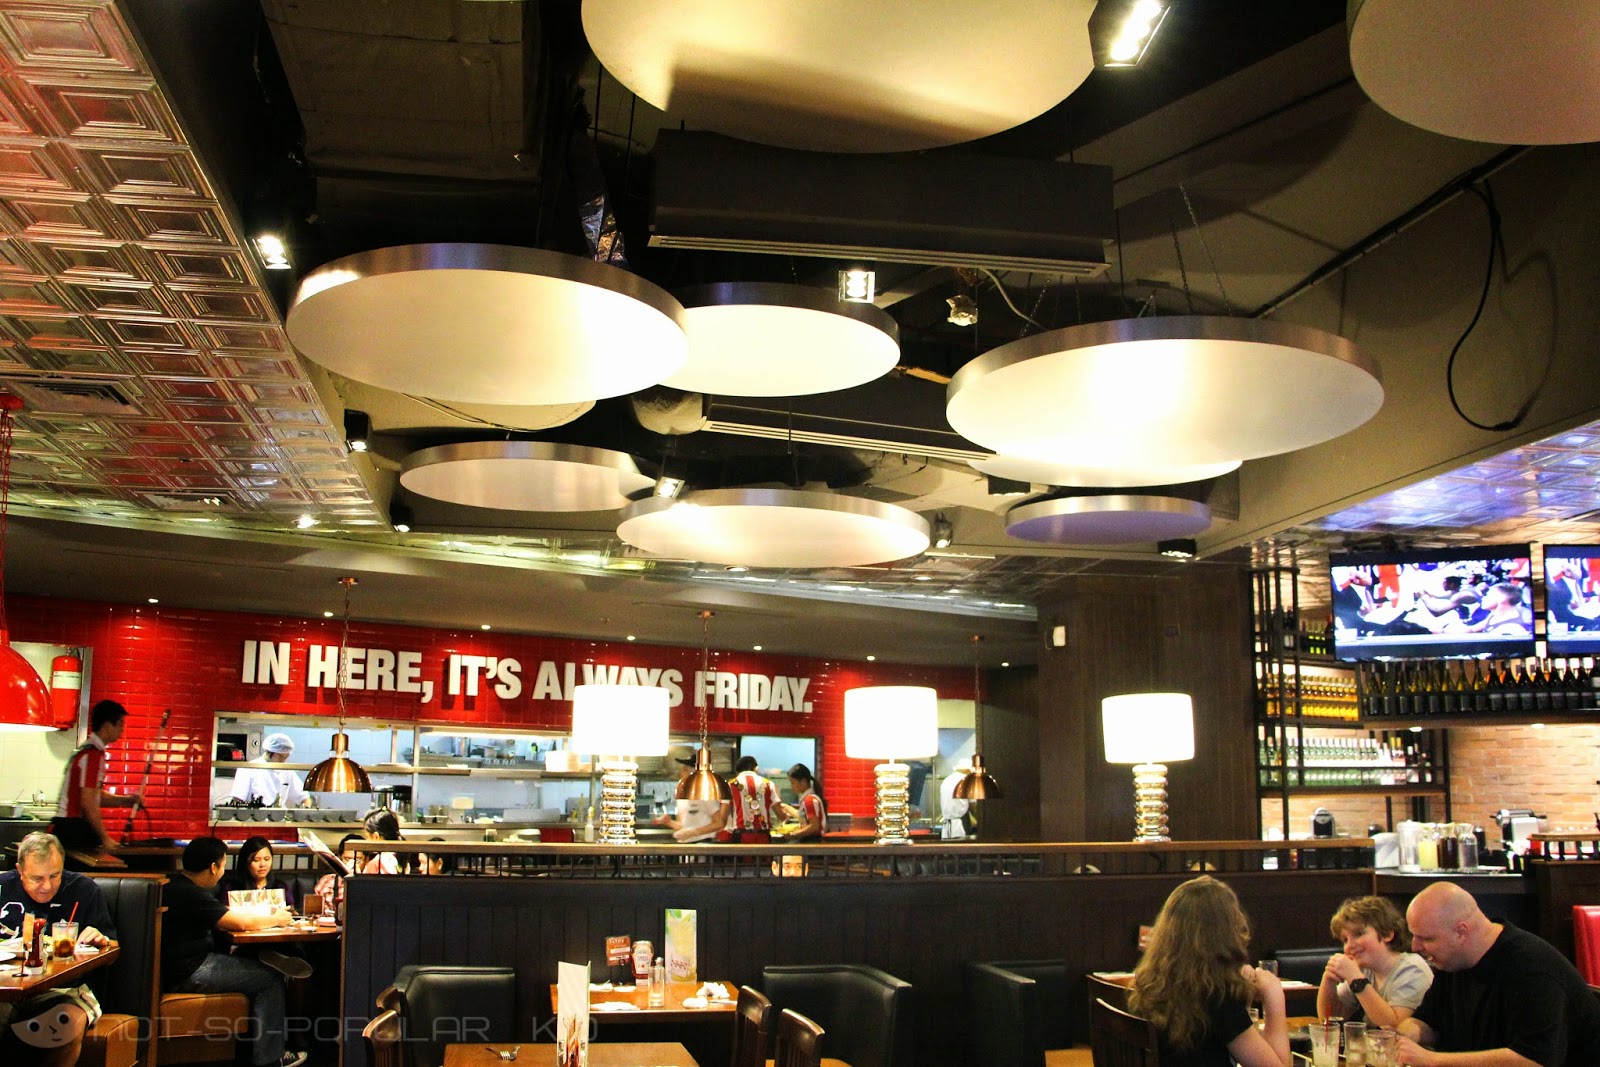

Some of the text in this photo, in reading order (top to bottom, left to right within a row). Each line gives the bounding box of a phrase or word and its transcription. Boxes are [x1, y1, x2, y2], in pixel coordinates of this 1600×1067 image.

[242, 640, 291, 685] IN
[307, 644, 434, 703] HERE,
[448, 654, 522, 700] IT'S
[694, 670, 813, 713] FRIDAY.
